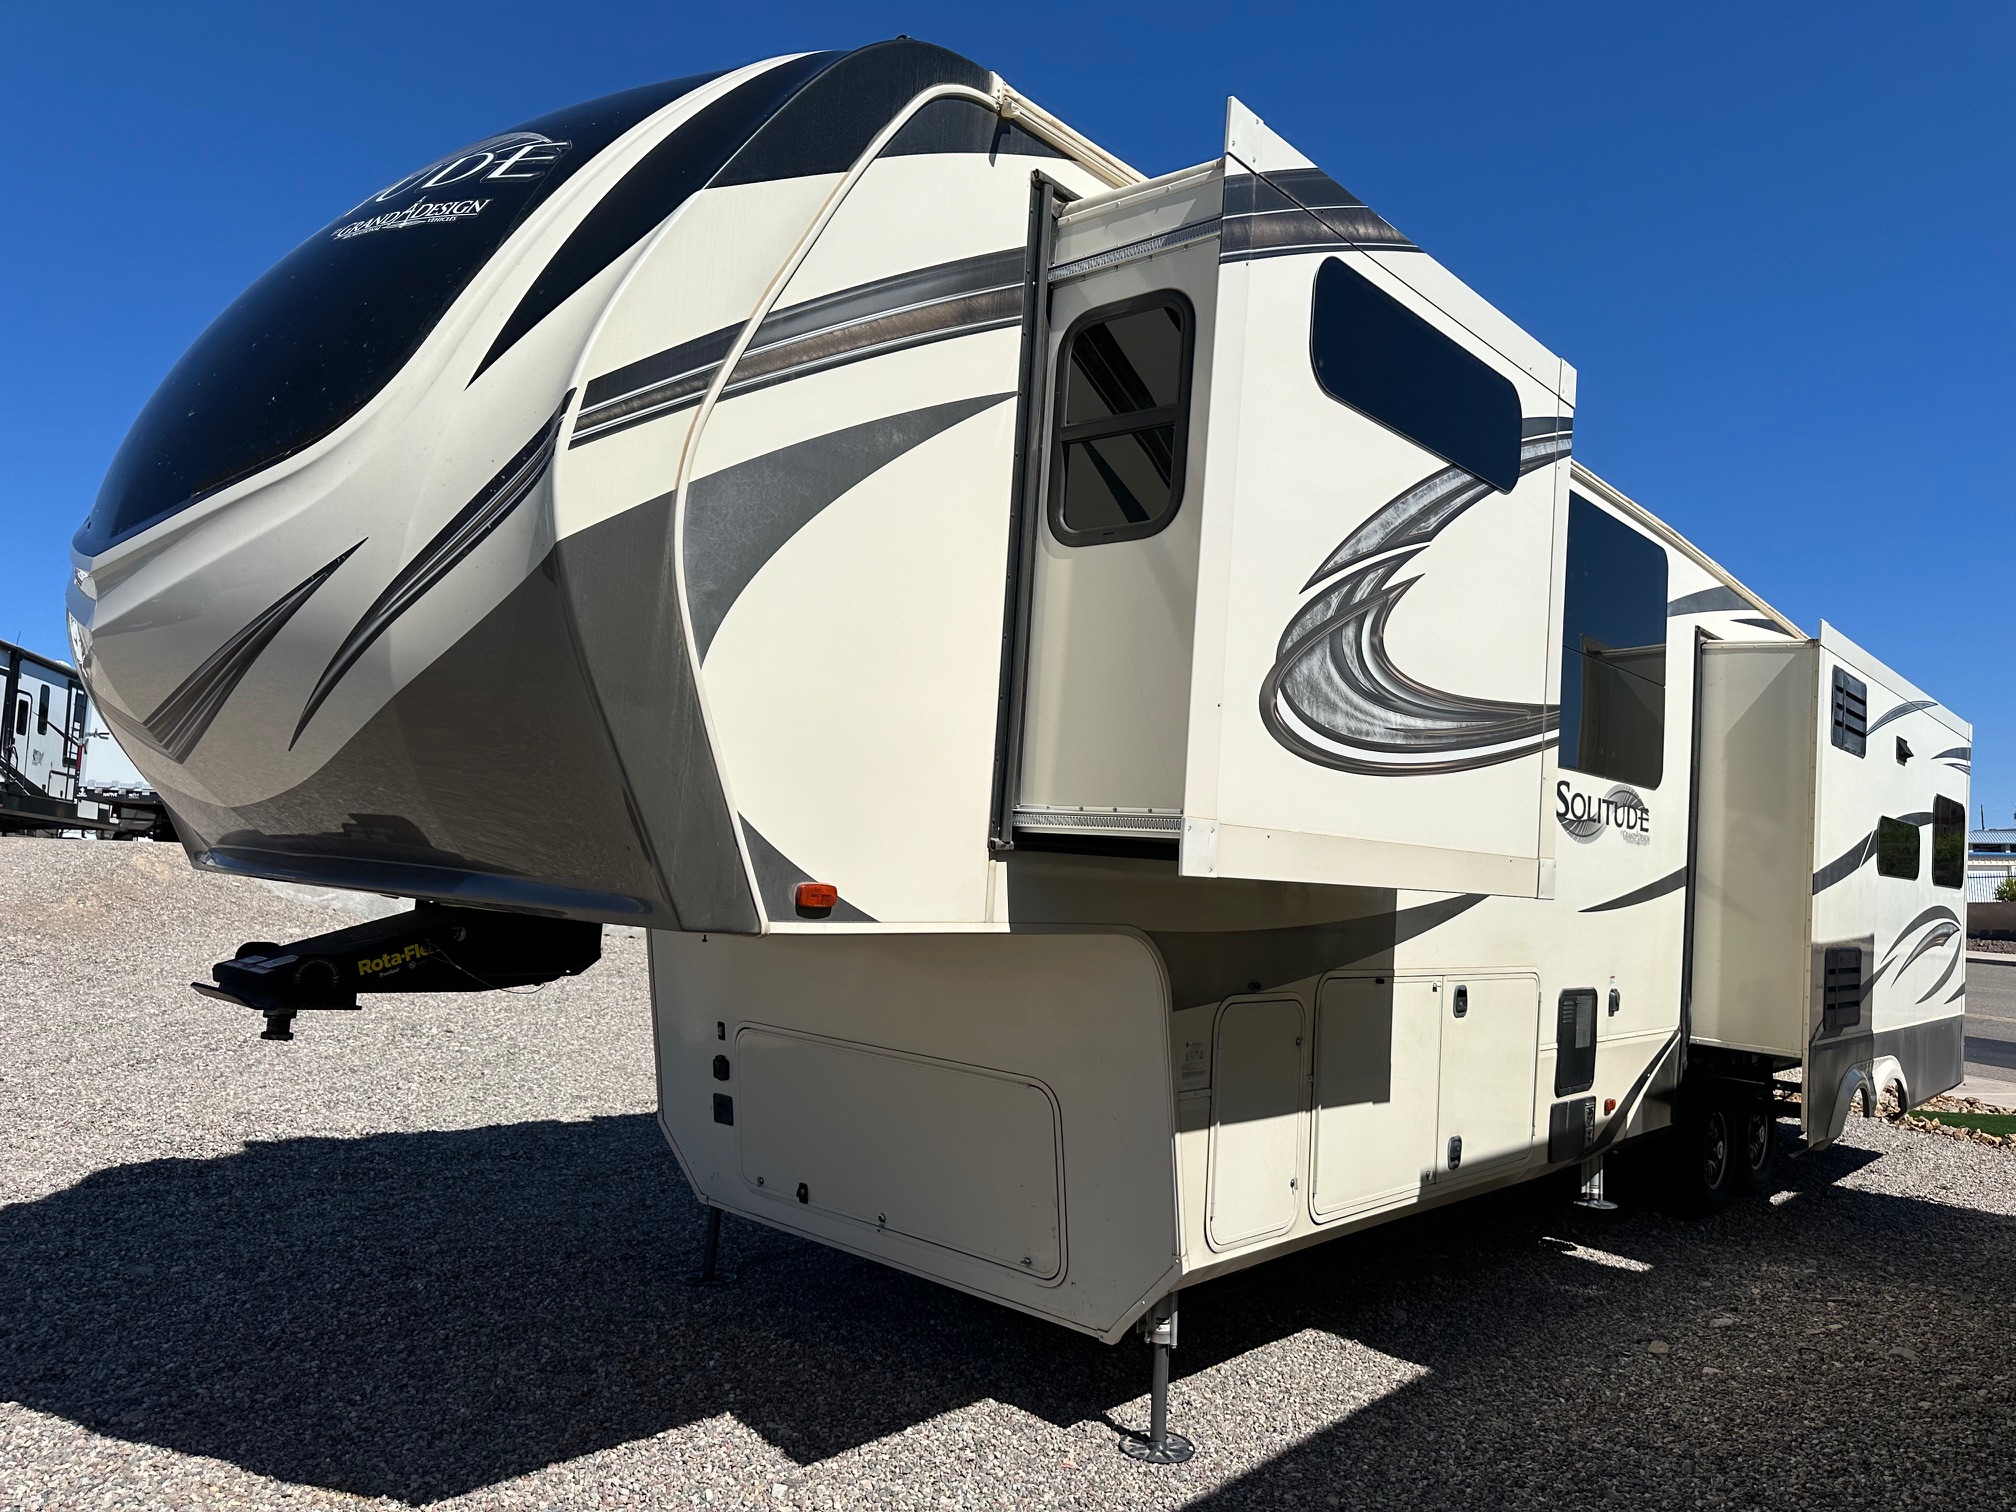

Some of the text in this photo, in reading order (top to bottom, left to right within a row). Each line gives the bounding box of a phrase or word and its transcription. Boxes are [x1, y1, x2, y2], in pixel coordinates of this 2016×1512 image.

[346, 139, 570, 216] UDE
[337, 211, 401, 237] GRAND
[410, 199, 492, 219] DESIGN
[1556, 780, 1649, 833] SOLITUDE
[357, 943, 432, 976] Rota-Fle
